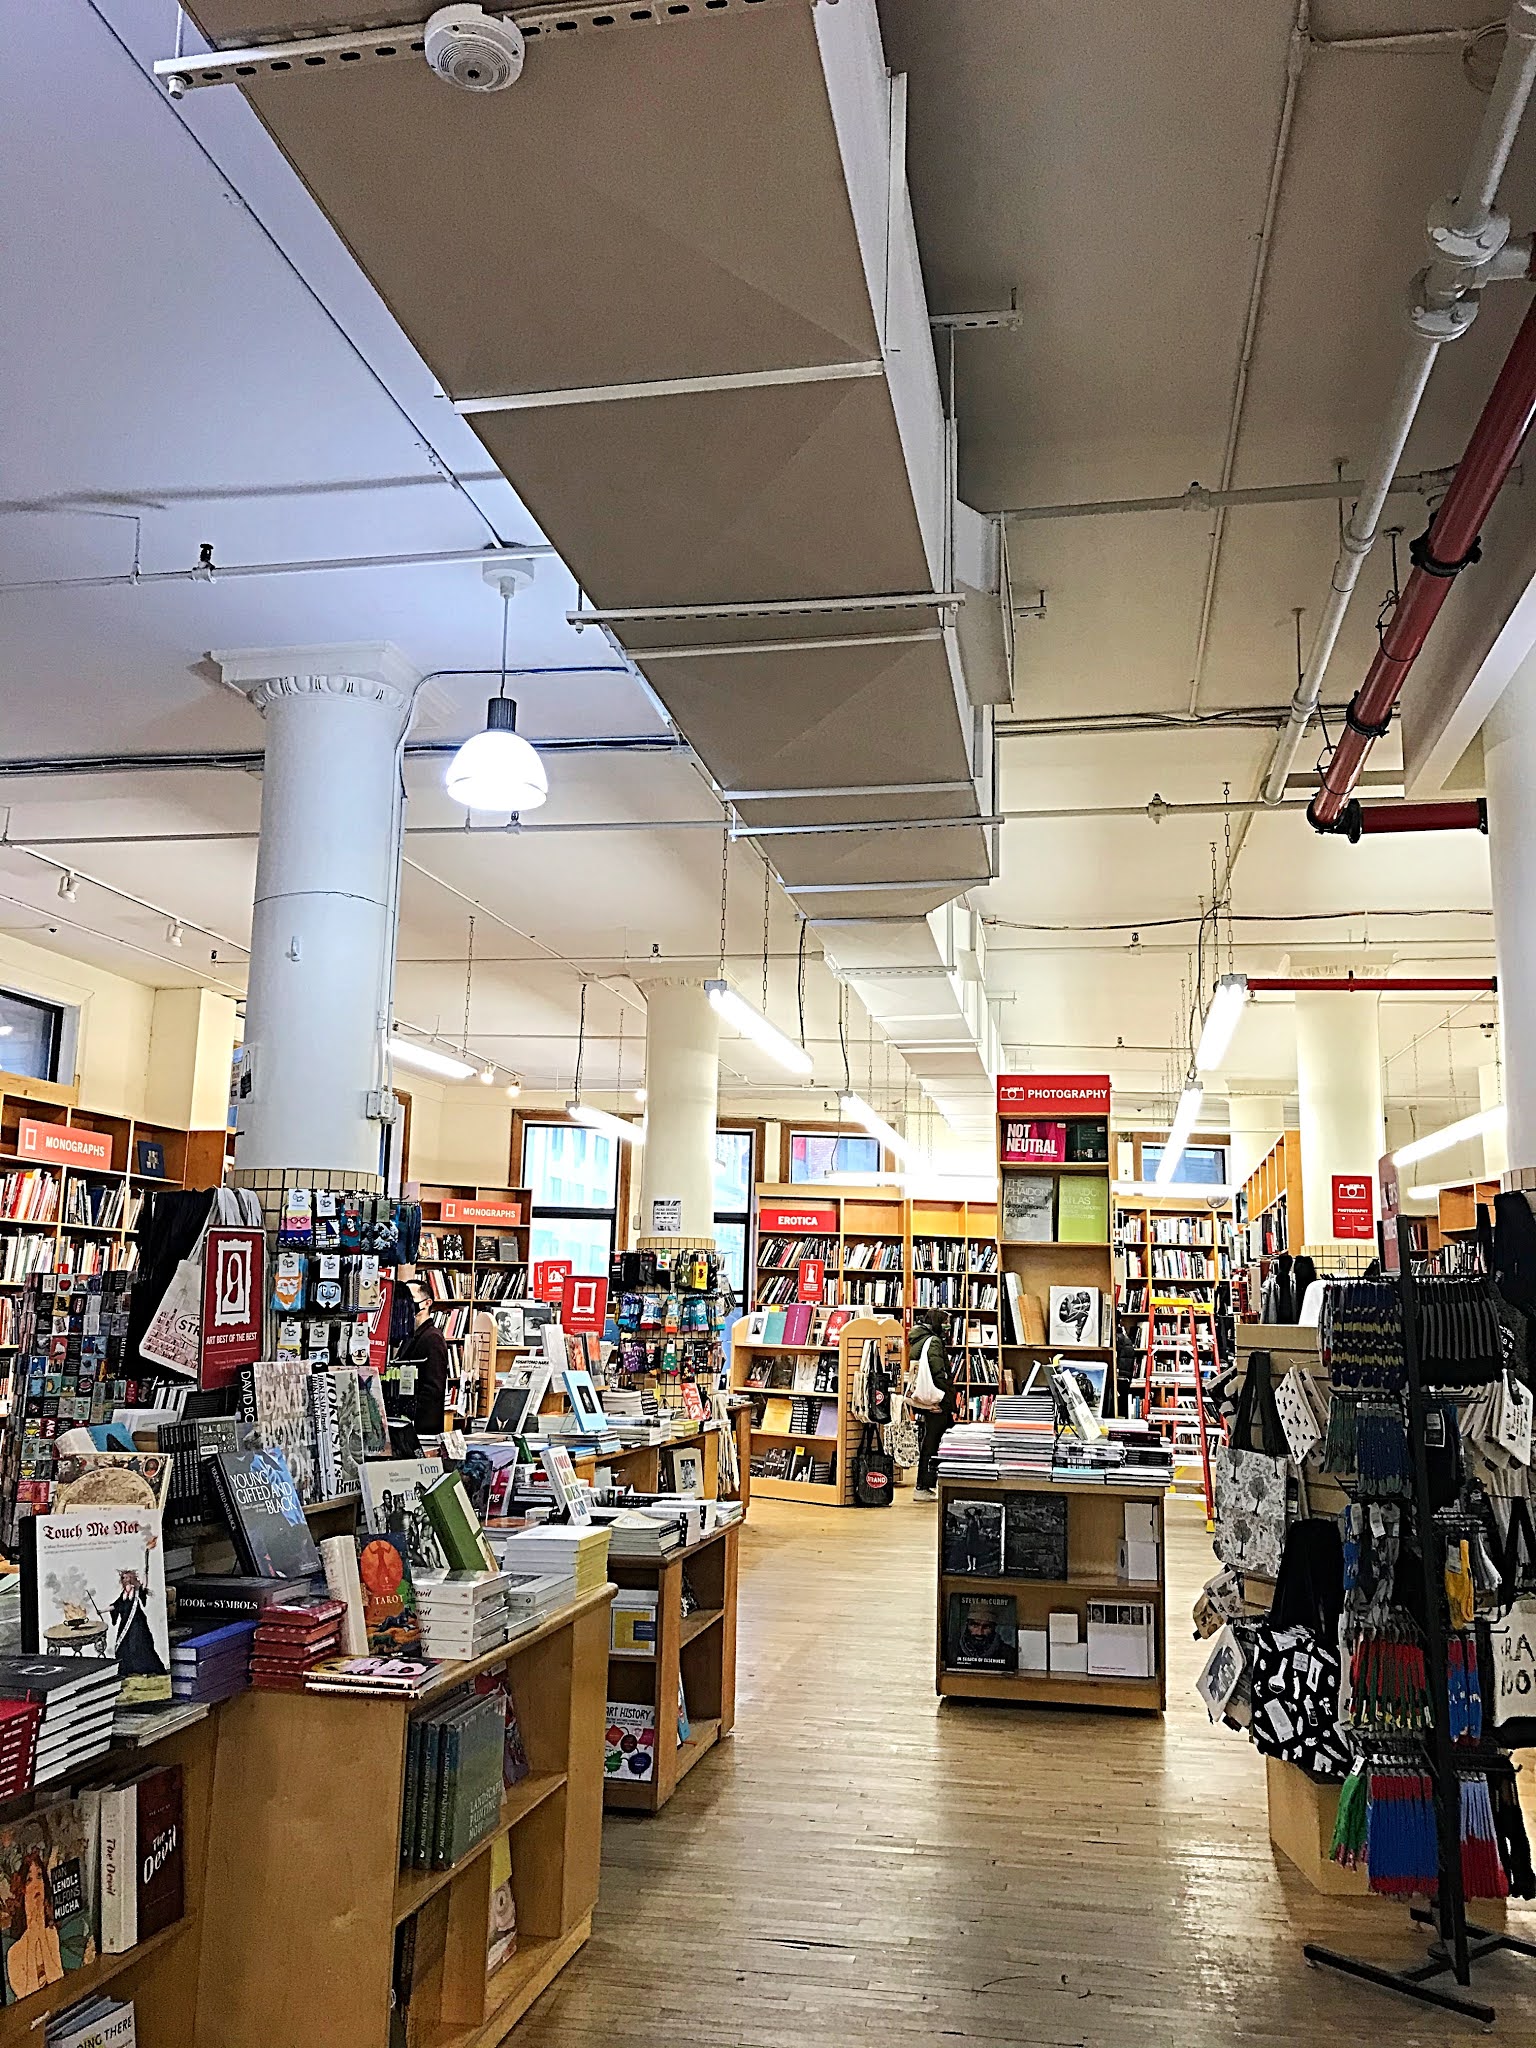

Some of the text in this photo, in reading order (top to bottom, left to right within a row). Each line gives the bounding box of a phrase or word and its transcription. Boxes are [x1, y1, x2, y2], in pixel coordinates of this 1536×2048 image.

[1027, 1089, 1108, 1099] PHOTOGRAPHY
[1007, 1123, 1032, 1139] NOT
[45, 1135, 105, 1157] MONOGRAPHS
[1006, 1138, 1058, 1155] NEUTRAL
[1006, 1187, 1050, 1197] PHAIDON
[1006, 1195, 1035, 1205] ATLAS
[463, 1207, 516, 1218] MONOGRAPHS
[777, 1215, 819, 1226] EROTICA
[178, 1319, 200, 1337] STR
[206, 1335, 216, 1345] ART
[216, 1334, 229, 1344] BEST
[228, 1333, 236, 1343] OF
[235, 1332, 246, 1342] THE
[245, 1331, 258, 1341] BEST
[240, 1370, 254, 1406] DAVID
[417, 1463, 439, 1475] Tom
[230, 1470, 270, 1490] YOUNG
[335, 1478, 361, 1495] Brus
[236, 1481, 293, 1505] GIFTED AND
[264, 1495, 298, 1515] BLACK
[43, 1520, 141, 1541] Touch Me Not
[180, 1598, 206, 1608] BOOK
[213, 1599, 259, 1610] SYMBOLS
[375, 1594, 403, 1606] TAROT
[961, 1596, 980, 1605] STEVE
[606, 1706, 652, 1720] ART HISTORY
[153, 1831, 166, 1851] The
[143, 1824, 177, 1884] Devil
[53, 1866, 67, 1881] IVAN
[105, 1838, 117, 1897] The Devil
[54, 1885, 81, 1906] ALFONS
[54, 1899, 80, 1920] MUCHA
[104, 2015, 132, 2041] THERE
